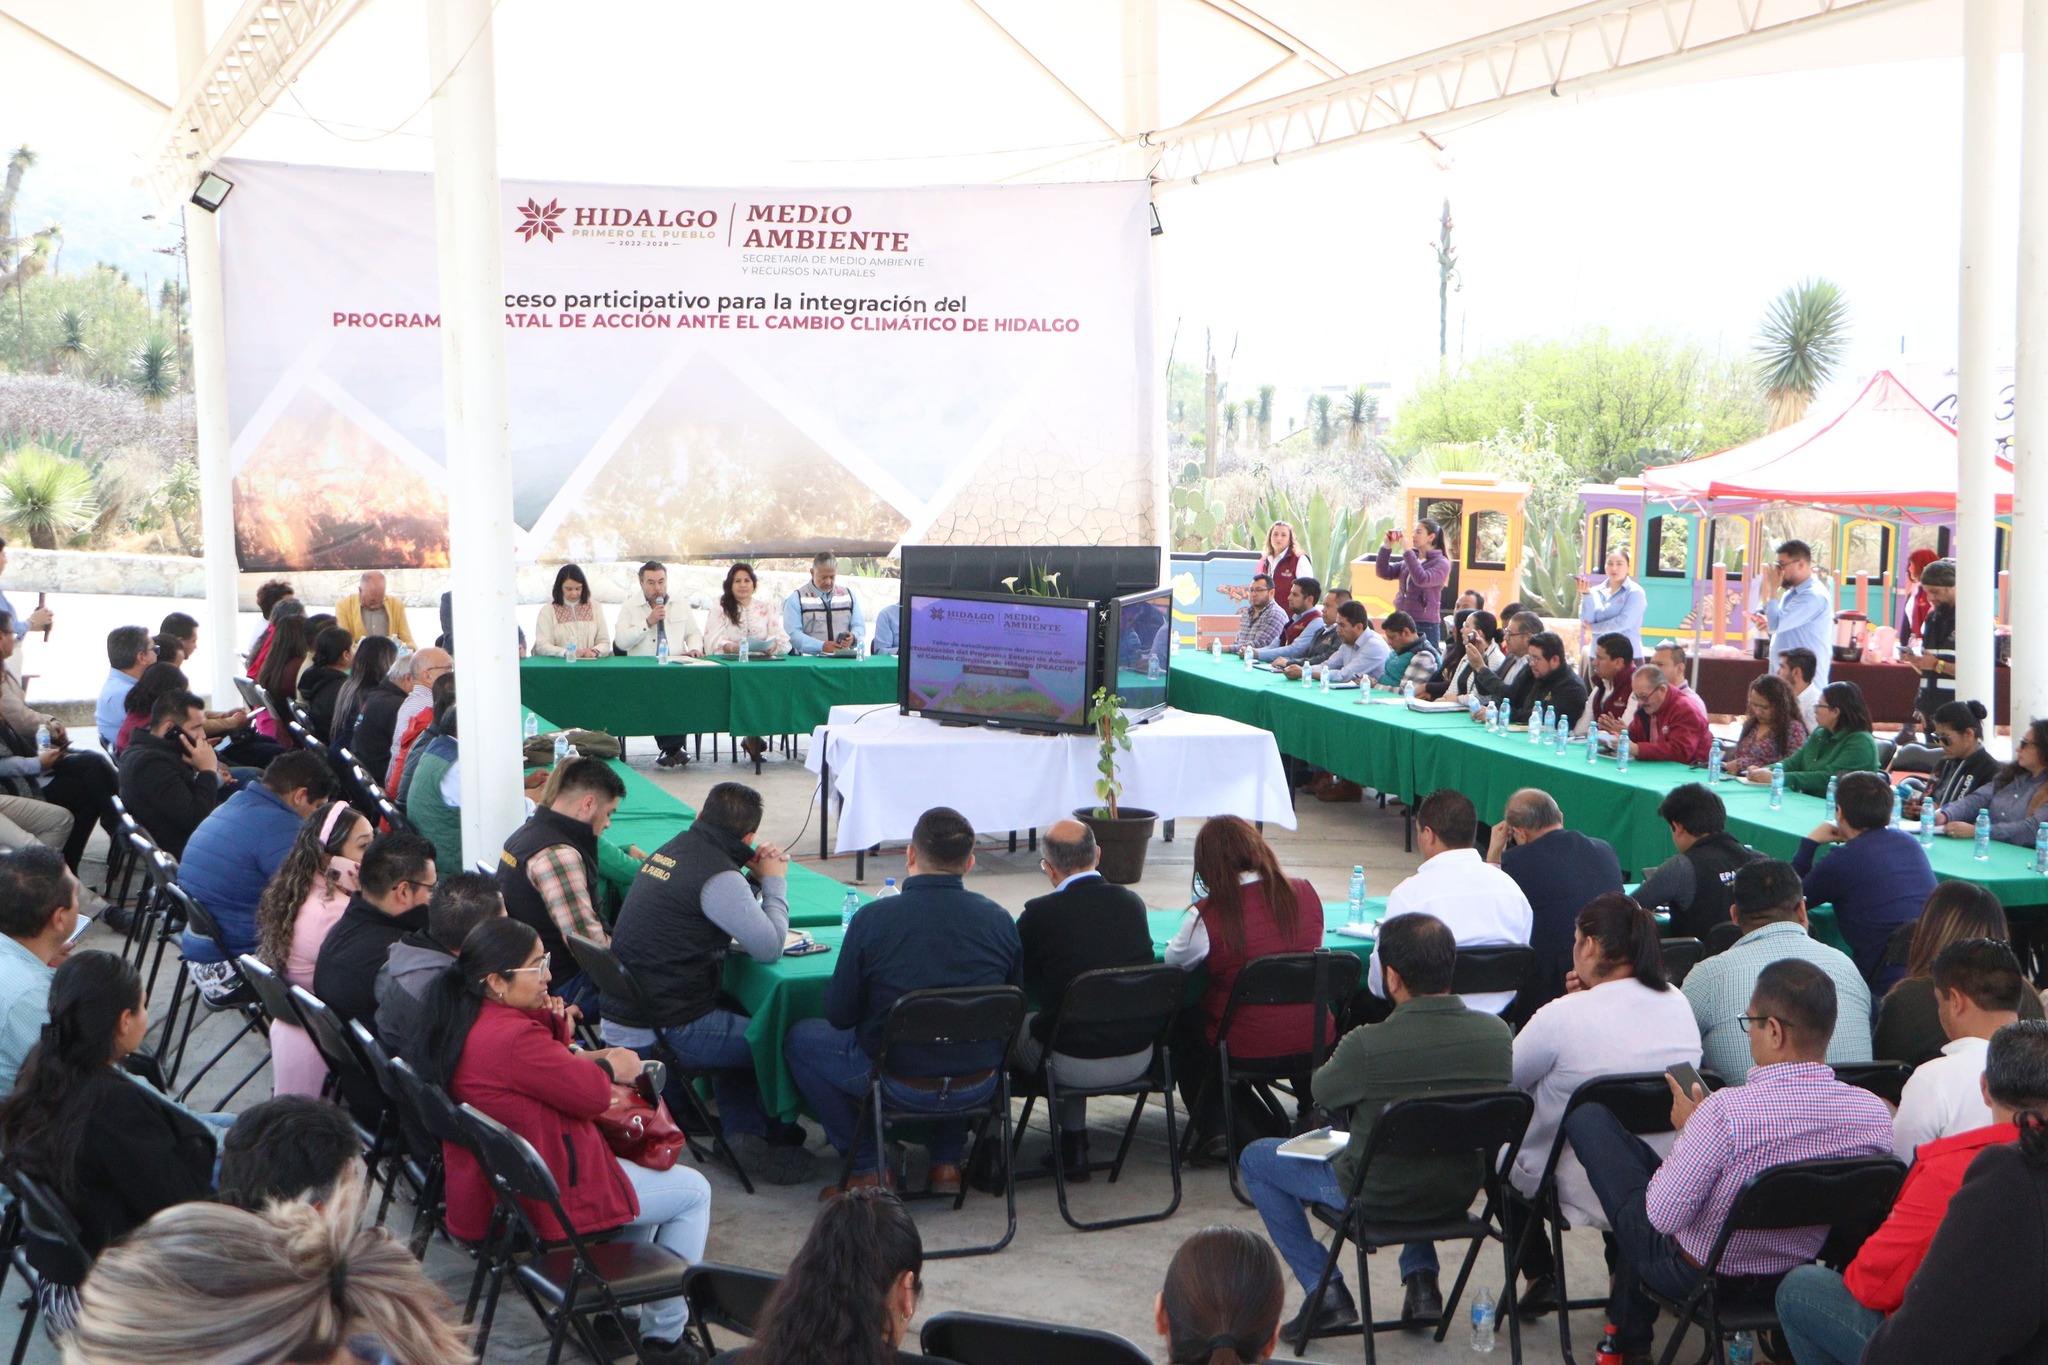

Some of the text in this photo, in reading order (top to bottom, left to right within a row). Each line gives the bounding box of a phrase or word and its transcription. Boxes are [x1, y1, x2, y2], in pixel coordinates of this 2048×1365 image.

[574, 207, 718, 228] HIDALGO
[746, 204, 852, 225] MEDIO
[572, 229, 716, 239] PRIMERO EL PUEBLO
[743, 228, 909, 252] AMBIENTE
[742, 253, 925, 267] SECRETARÍA DE MEDIO AMBIENTE
[742, 266, 876, 277] Y RECURSOS NATURALES
[505, 290, 966, 315] ceso participativo para la integración del
[333, 310, 1080, 332] PROGRAM ATAL DE ACCIÓN ANTE EL CAMBIO CLIMÁTICO DE HIDALGO
[947, 610, 995, 620] HIDALGO
[1004, 612, 1040, 622] MEDIO
[1003, 621, 1062, 632] AMBIENTE
